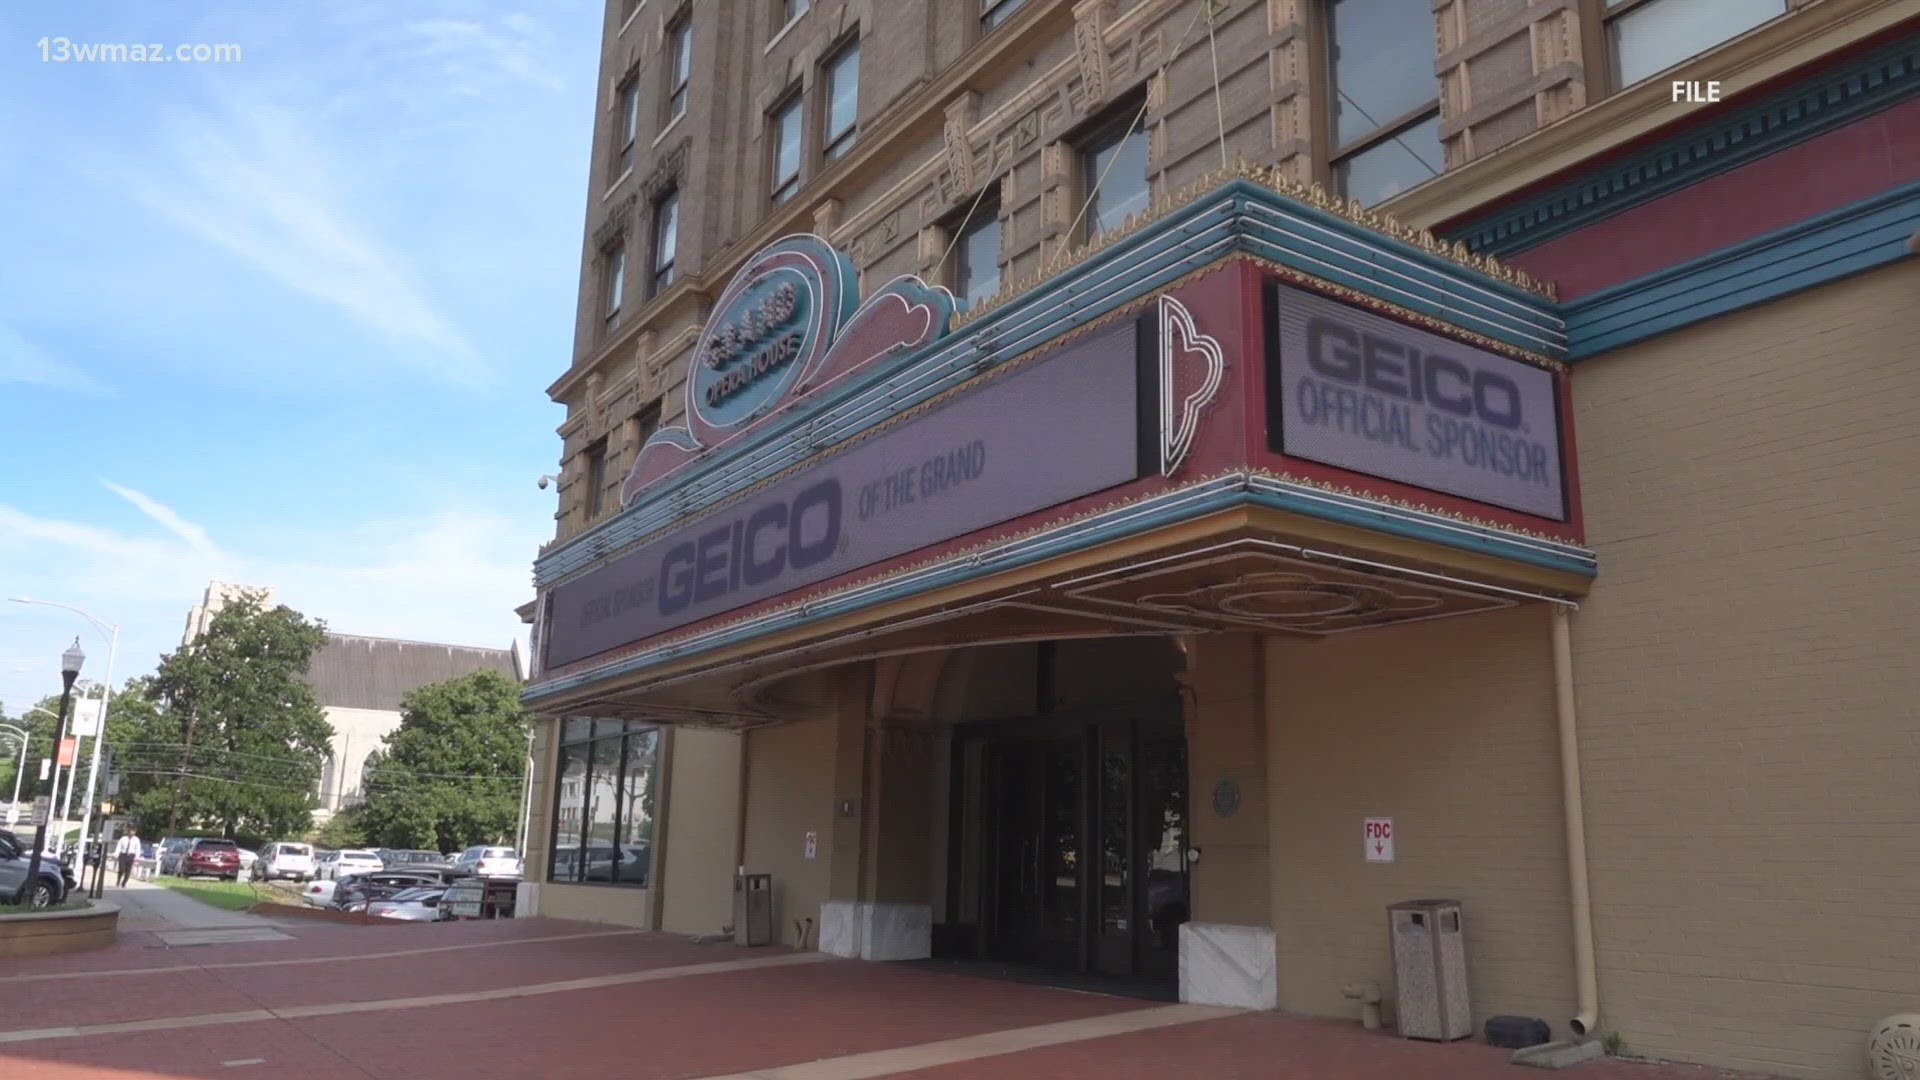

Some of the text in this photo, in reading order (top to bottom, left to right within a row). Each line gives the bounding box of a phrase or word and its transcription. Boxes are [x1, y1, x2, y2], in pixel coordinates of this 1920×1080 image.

[749, 332, 801, 381] HOUSE
[1306, 316, 1522, 430] GEICO
[1297, 374, 1550, 487] OFFICIAL SPONSOR
[657, 477, 843, 617] GEICO
[859, 481, 881, 520] OF
[884, 466, 917, 511] THE
[919, 440, 985, 499] GRAND
[1366, 822, 1391, 839] FDC
